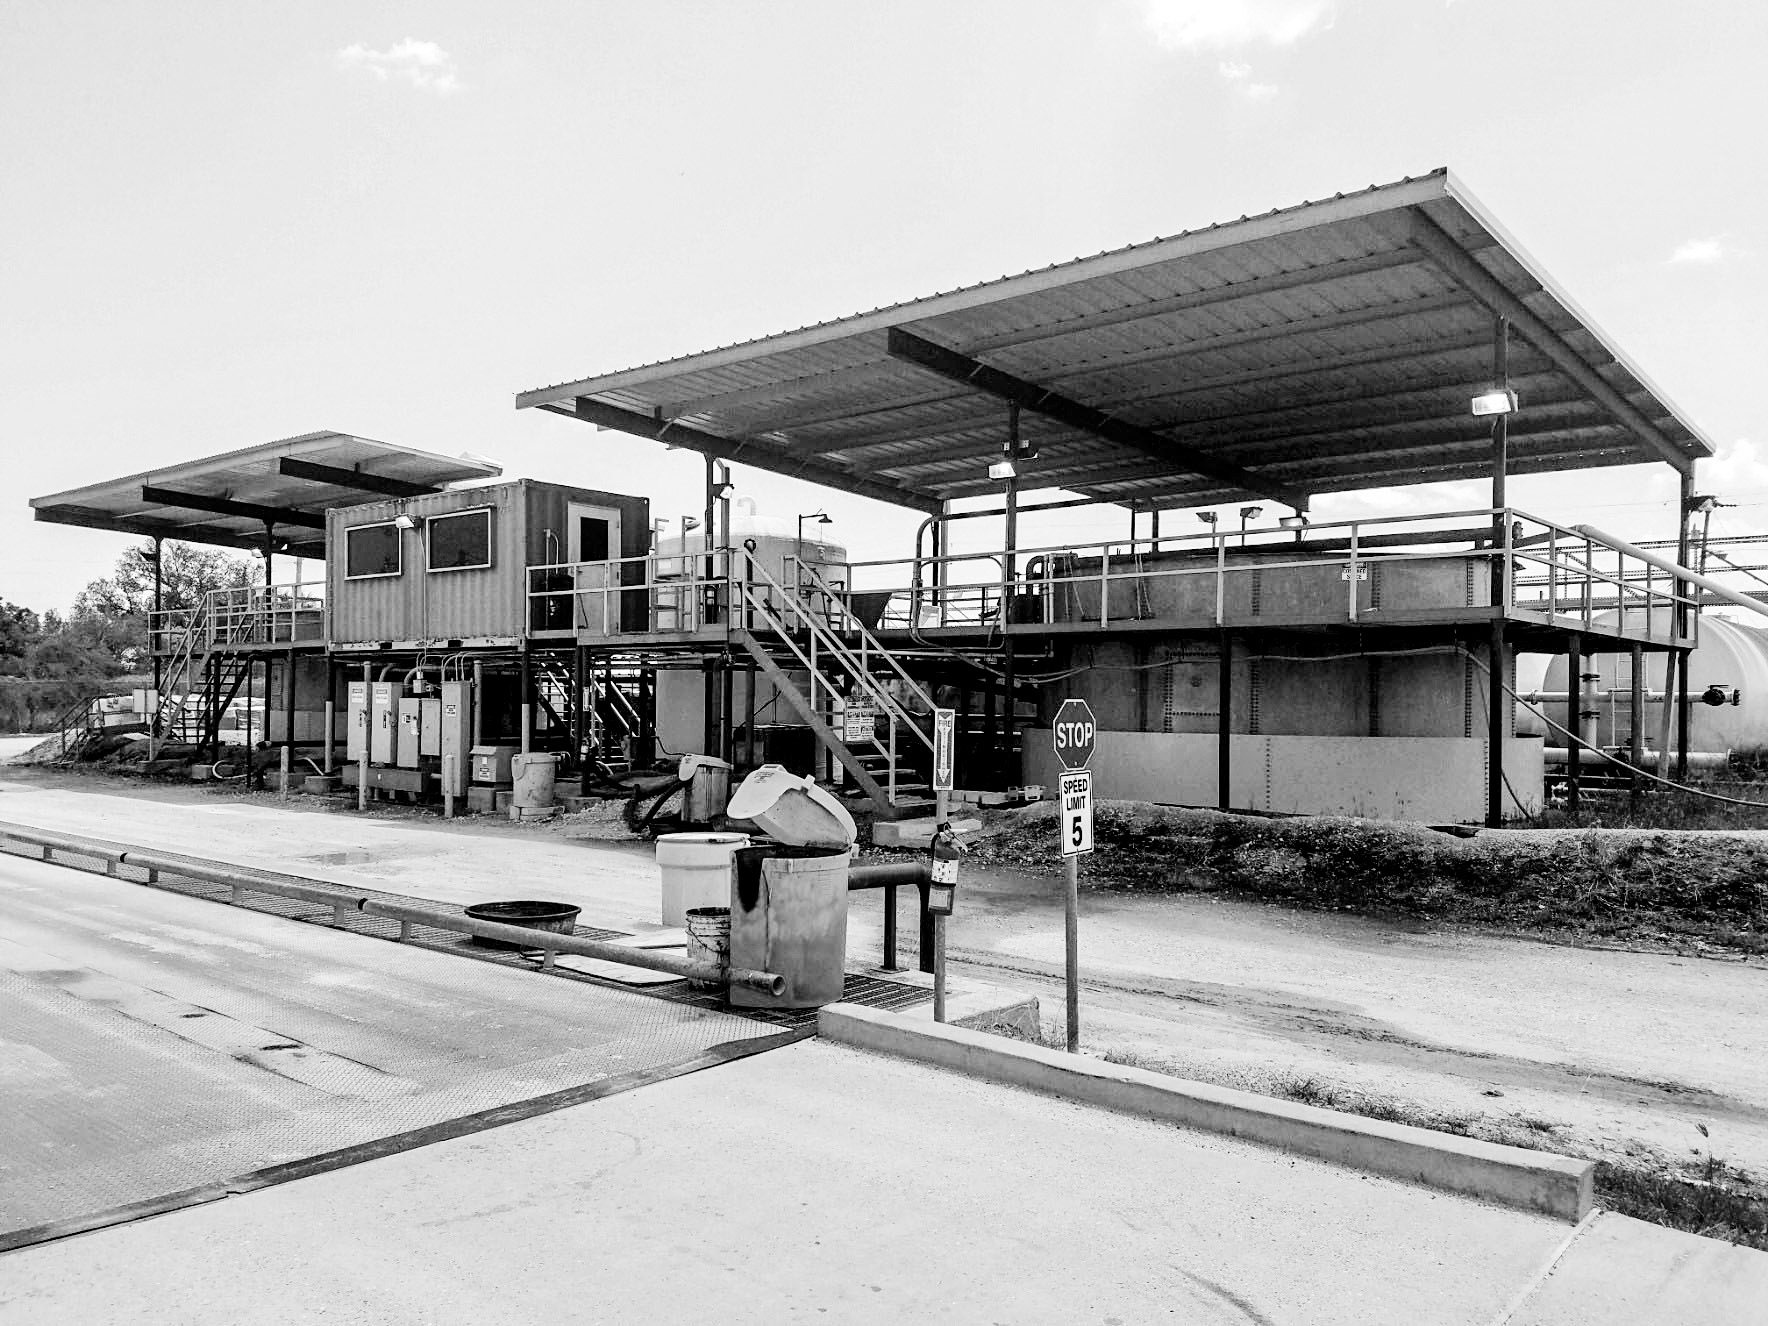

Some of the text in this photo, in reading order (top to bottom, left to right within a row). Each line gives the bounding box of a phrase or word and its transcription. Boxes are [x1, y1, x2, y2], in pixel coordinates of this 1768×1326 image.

[1057, 722, 1093, 748] STOP
[1064, 779, 1088, 794] SPEED
[1066, 795, 1086, 811] LIMIT
[1072, 815, 1083, 847] 5
